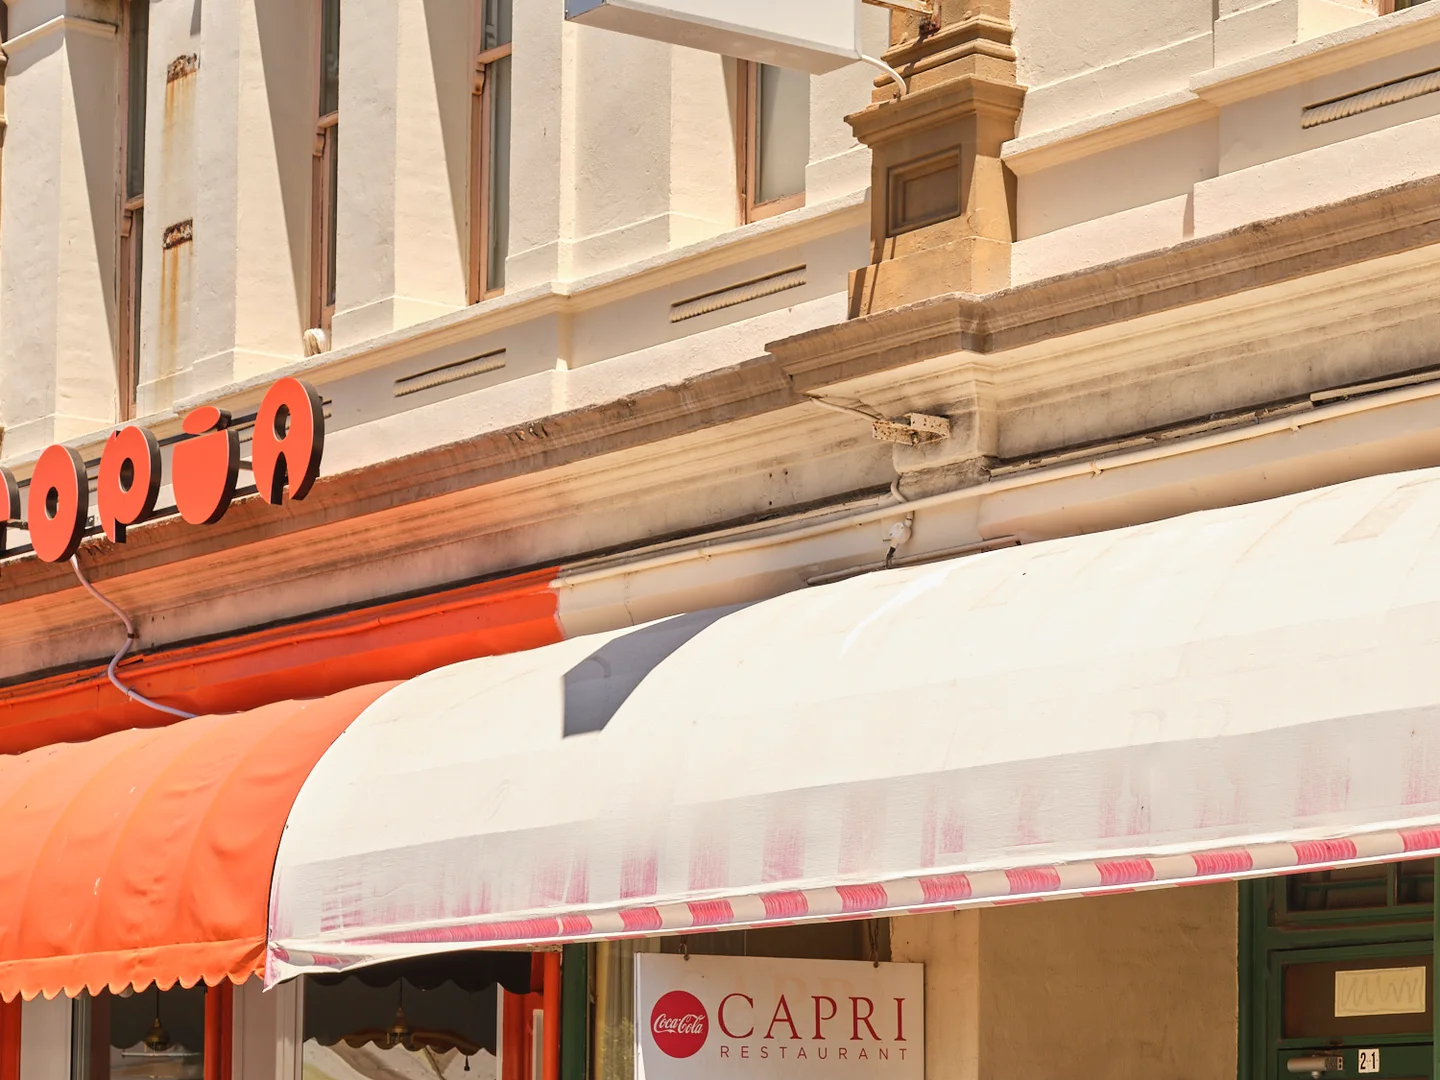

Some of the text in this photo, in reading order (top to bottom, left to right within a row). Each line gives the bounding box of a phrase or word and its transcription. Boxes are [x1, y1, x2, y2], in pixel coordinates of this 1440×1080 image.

[0, 376, 325, 563] OPIA
[718, 993, 907, 1042] CAPRI
[720, 1045, 907, 1060] RESTAURANT
[1360, 1052, 1376, 1070] 21
